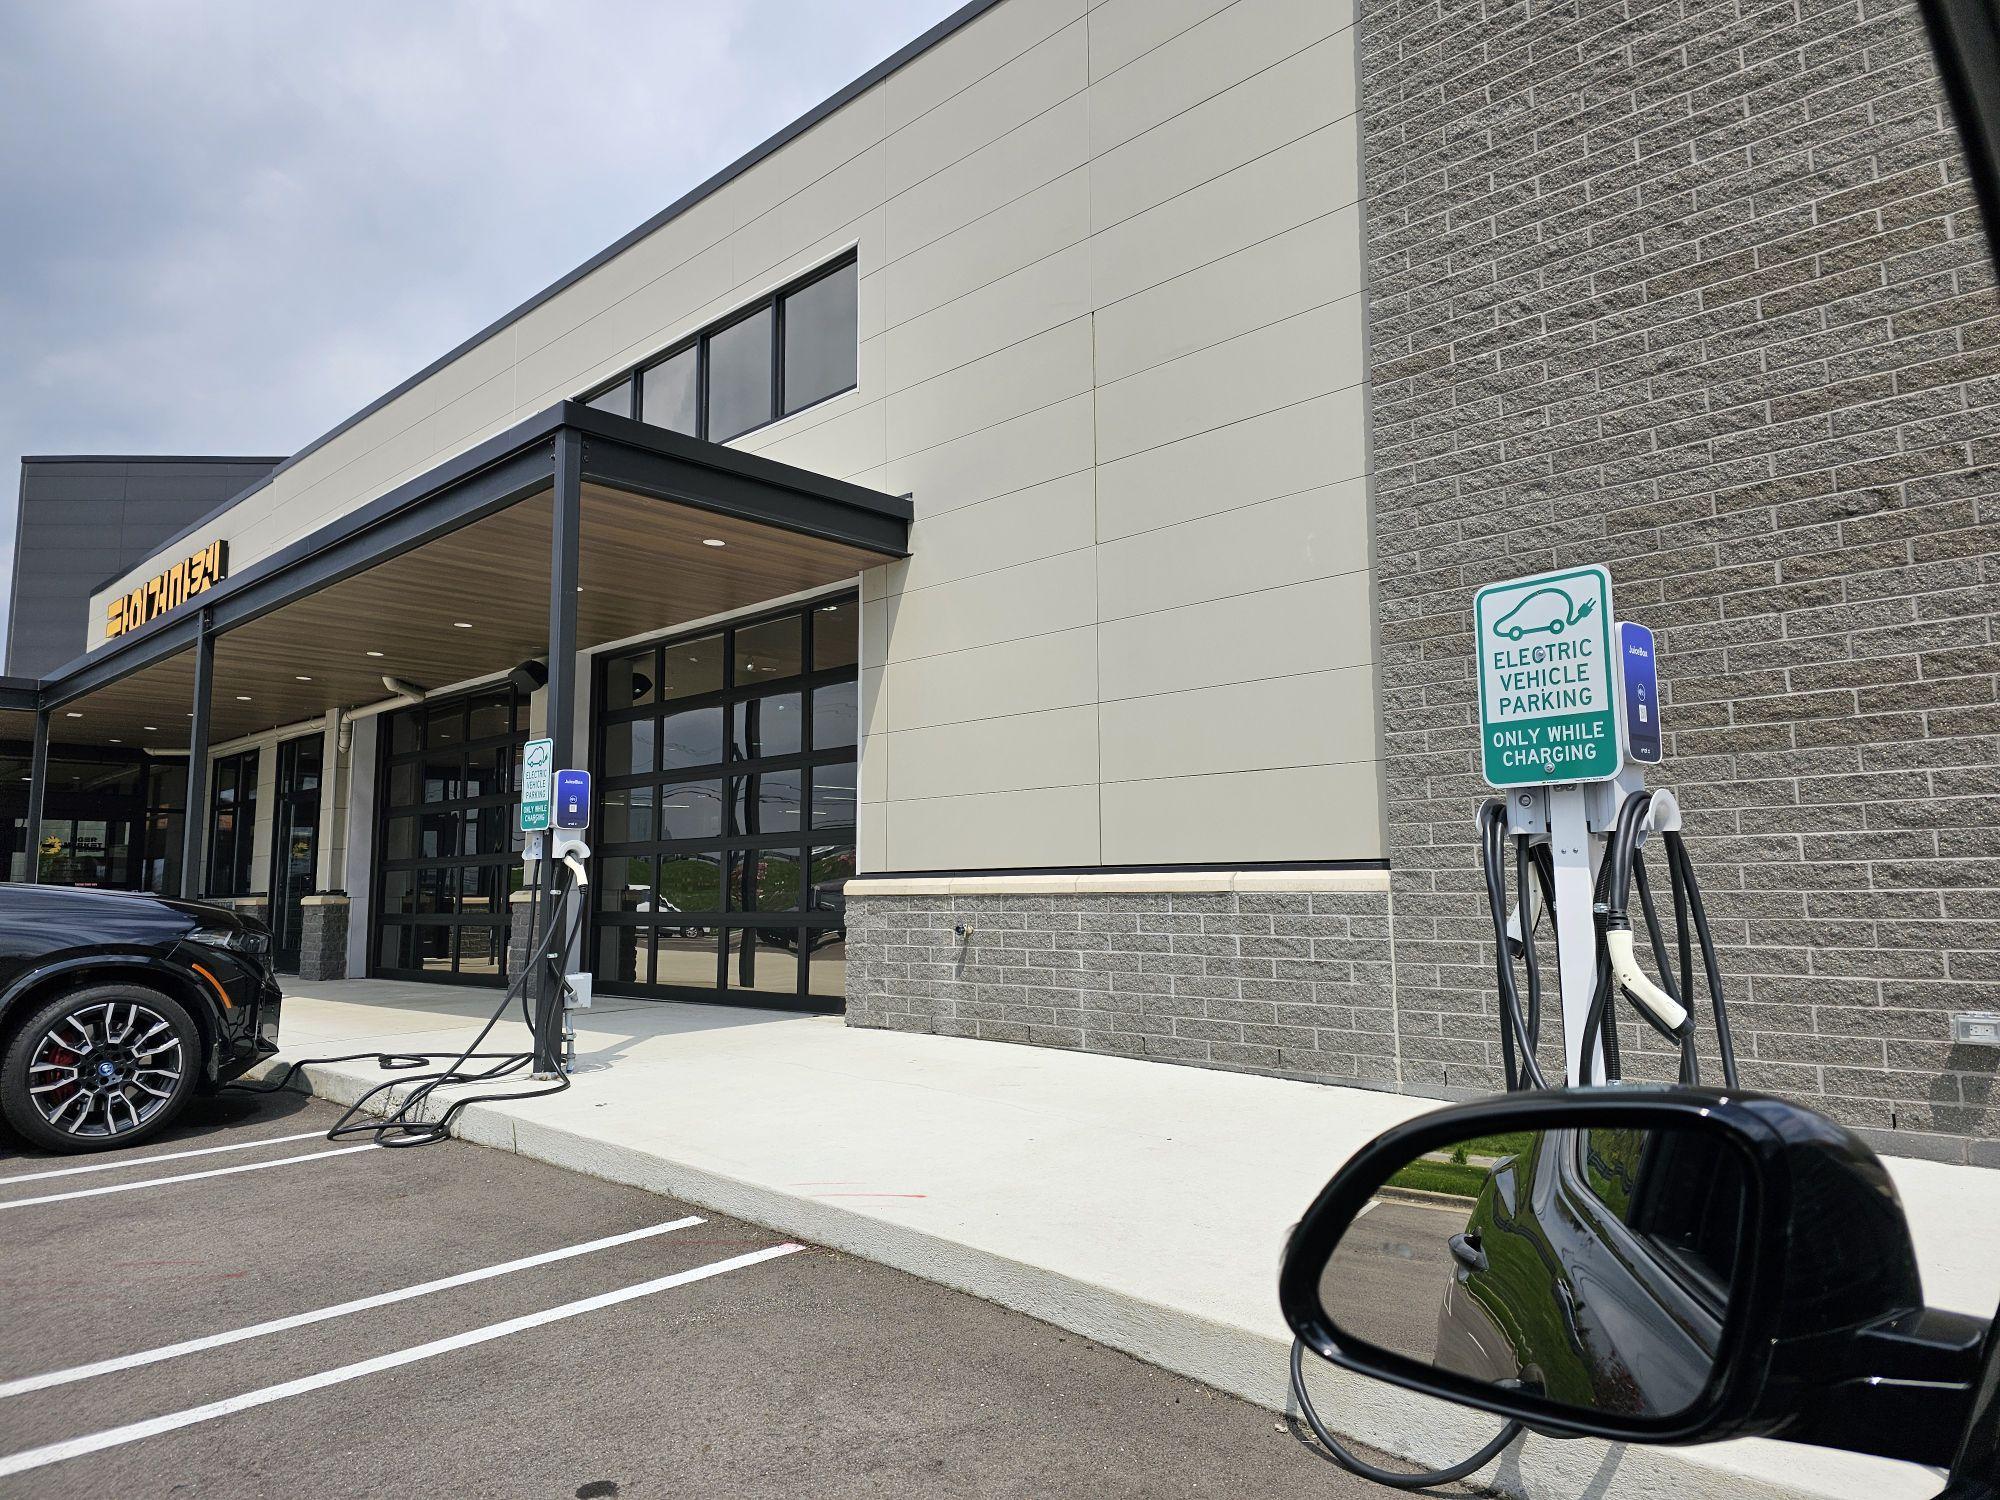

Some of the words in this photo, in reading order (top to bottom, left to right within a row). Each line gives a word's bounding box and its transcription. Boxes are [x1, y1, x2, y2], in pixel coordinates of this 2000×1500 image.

[1494, 638, 1593, 670] ELECTRIC
[1500, 663, 1590, 691] VEHICLE
[1499, 687, 1593, 715] PARKING
[1493, 727, 1541, 748] ONLY
[1547, 721, 1605, 743] WHILE
[1502, 743, 1597, 767] CHARGING
[525, 769, 548, 780] ELECTRIC
[526, 779, 546, 790] VEHICLE
[525, 790, 546, 799] PARKING
[523, 805, 534, 814] ONLY
[535, 804, 548, 813] WHILE
[524, 812, 545, 822] CHARGING
